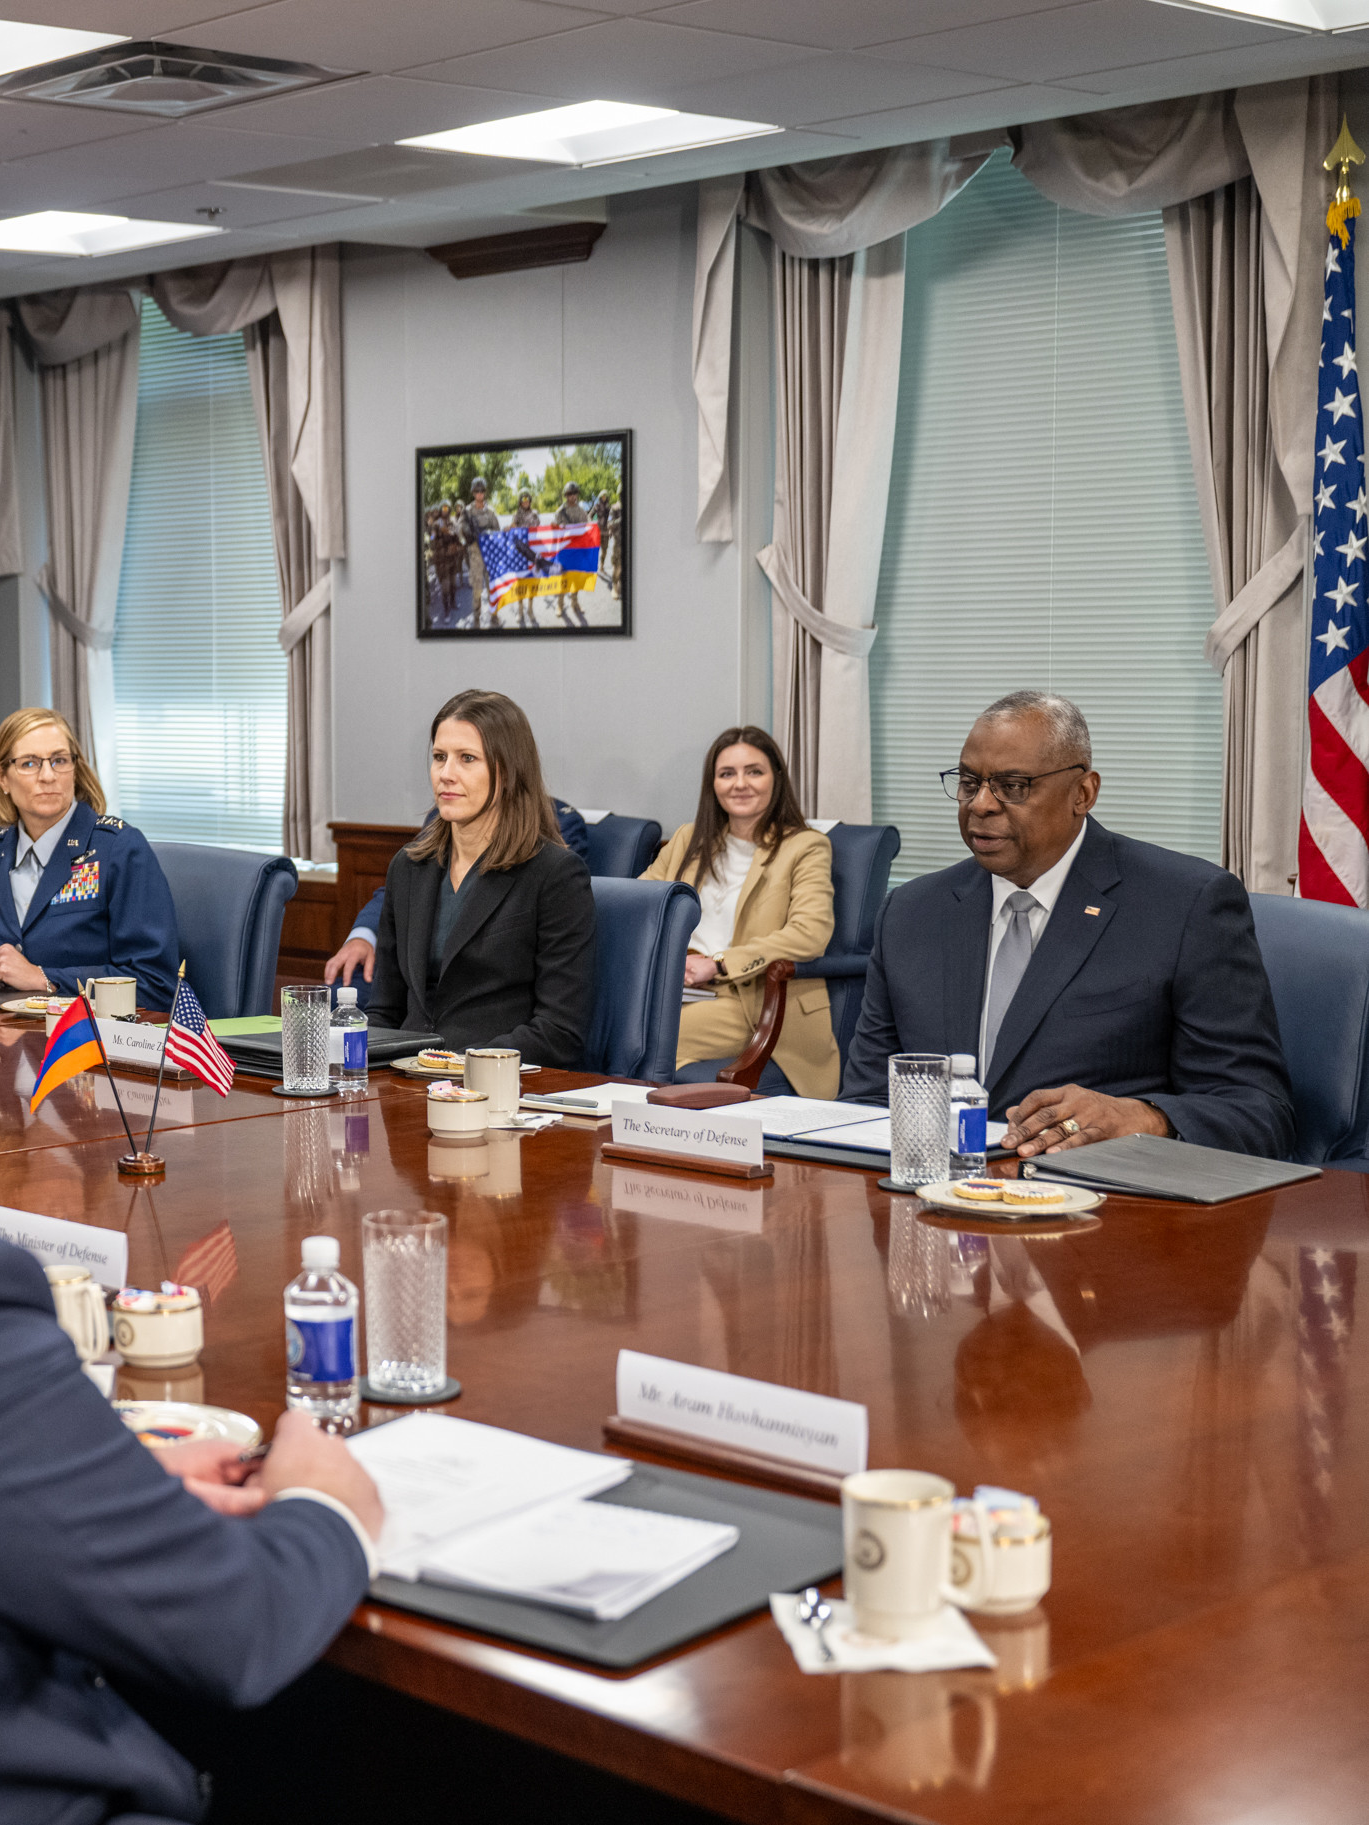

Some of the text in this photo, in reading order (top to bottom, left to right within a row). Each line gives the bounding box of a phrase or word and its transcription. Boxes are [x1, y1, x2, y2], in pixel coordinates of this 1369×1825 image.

[113, 1034, 124, 1046] Ms.
[127, 1037, 155, 1050] Caroline
[623, 1118, 748, 1147] The Secretary of Defense
[17, 1231, 55, 1252] Minister
[56, 1242, 68, 1259] of
[69, 1242, 108, 1264] Defense
[638, 1381, 661, 1402] Mr.
